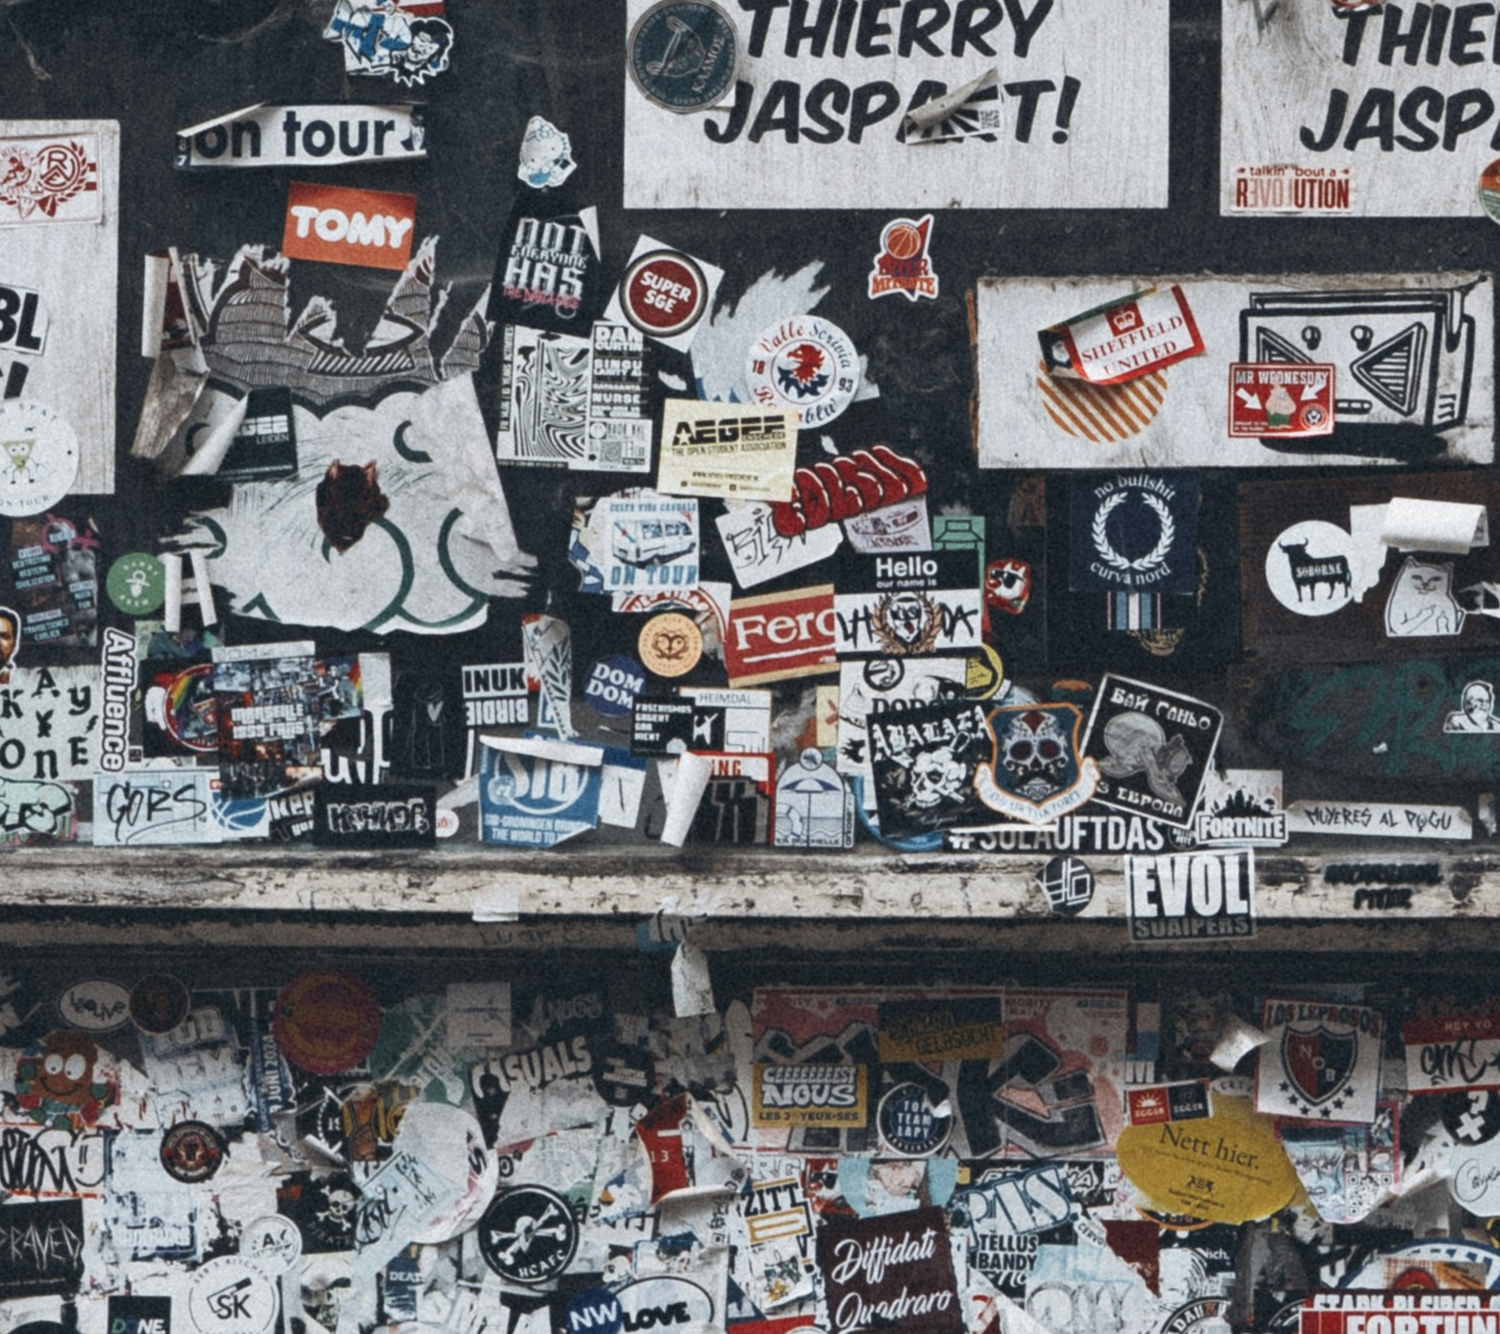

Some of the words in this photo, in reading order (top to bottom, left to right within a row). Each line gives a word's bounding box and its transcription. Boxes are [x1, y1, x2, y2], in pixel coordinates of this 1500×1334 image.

[282, 112, 395, 157] tour
[290, 206, 411, 249] TOMY
[640, 273, 692, 302] SUPER
[644, 290, 677, 312] SGE
[1081, 315, 1184, 363] SHEFFIELD
[1102, 340, 1177, 376] UNITED
[1236, 370, 1254, 385] MR
[1259, 369, 1330, 385] WEDNESDAY
[673, 416, 785, 446] AEGEE
[672, 446, 688, 455] THE
[690, 446, 712, 455] OPEN
[715, 444, 750, 454] STUDENT
[753, 441, 786, 452] ASSOCIATION
[1095, 487, 1113, 500] no
[1117, 475, 1174, 501] bullshit
[876, 557, 938, 577] Hello
[877, 580, 895, 588] our
[899, 579, 922, 587] name
[926, 578, 936, 586] is
[463, 670, 525, 692] INUK
[102, 628, 136, 773] Affluence
[1199, 814, 1287, 842] FORTNITE
[1133, 854, 1248, 917] EVOL
[760, 1082, 857, 1107] NOUS
[1158, 1121, 1208, 1157] Nett
[1215, 1139, 1260, 1171] hier.
[833, 1229, 937, 1285] Diffidati
[978, 1235, 1039, 1255] TELLUS
